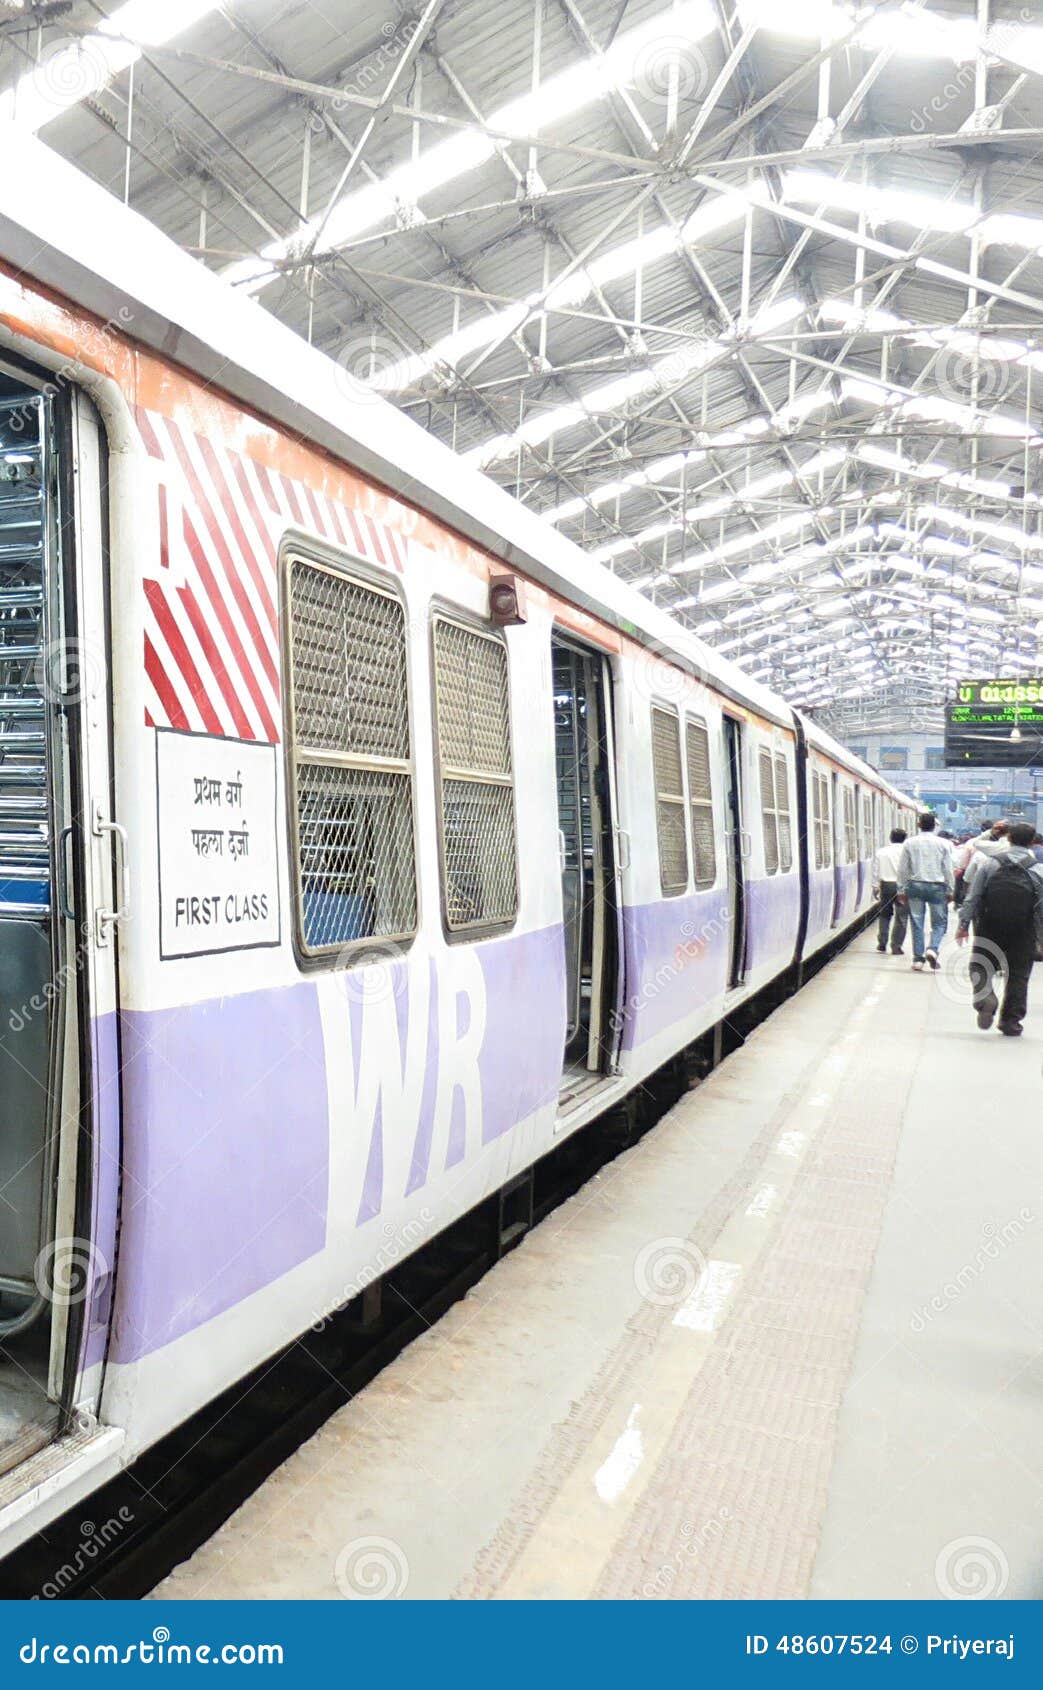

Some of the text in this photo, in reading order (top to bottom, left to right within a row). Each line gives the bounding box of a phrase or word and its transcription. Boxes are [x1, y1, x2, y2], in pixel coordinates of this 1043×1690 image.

[193, 770, 243, 808] प्रथम वर्ग
[191, 820, 249, 861] पहला दर्जा
[175, 894, 269, 927] FIRST CLASS
[315, 948, 488, 1246] WR
